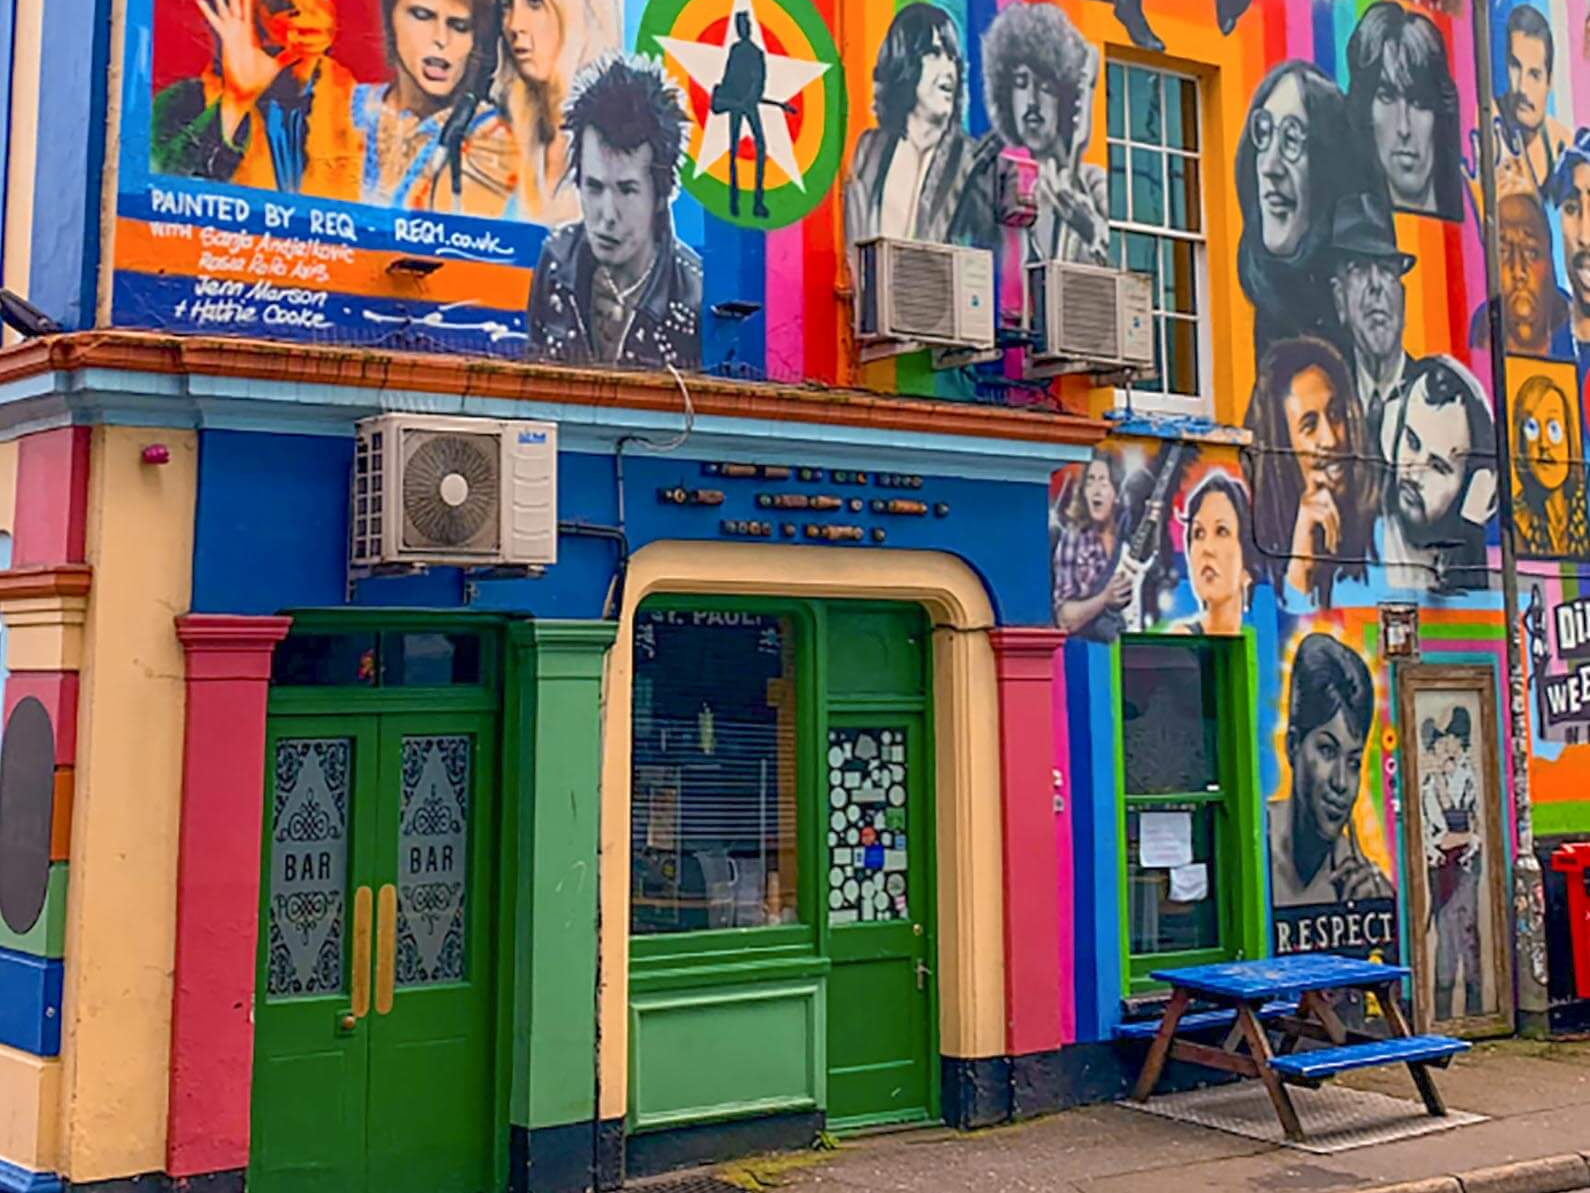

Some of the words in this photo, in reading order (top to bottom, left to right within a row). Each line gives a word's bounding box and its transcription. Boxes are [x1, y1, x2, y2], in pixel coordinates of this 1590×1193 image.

[151, 189, 250, 222] PAINTED
[264, 202, 296, 228] BY
[309, 209, 358, 241] REQ
[284, 852, 331, 882] BAR
[409, 845, 454, 875] BAR
[1276, 912, 1393, 954] RESPECT
